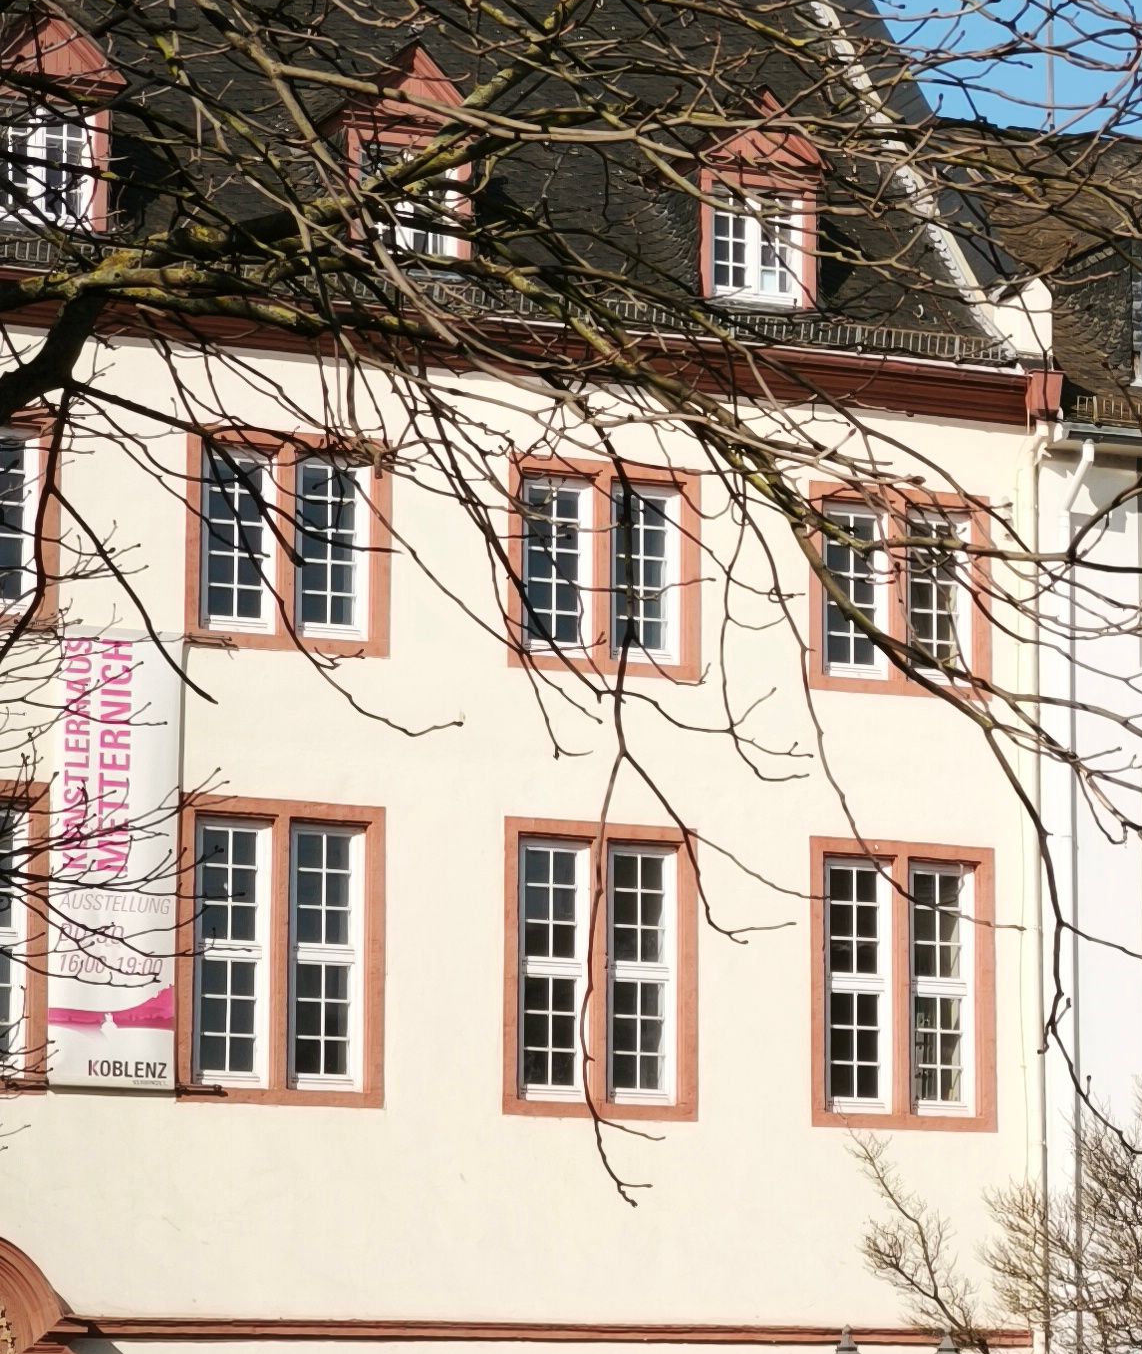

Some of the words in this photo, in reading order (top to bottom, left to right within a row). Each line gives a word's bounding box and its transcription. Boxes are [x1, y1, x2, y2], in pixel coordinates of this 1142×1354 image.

[97, 639, 133, 872] METTERNICH
[59, 893, 172, 915] AUSSTELLUNG
[88, 1059, 168, 1079] KOBLENZ
